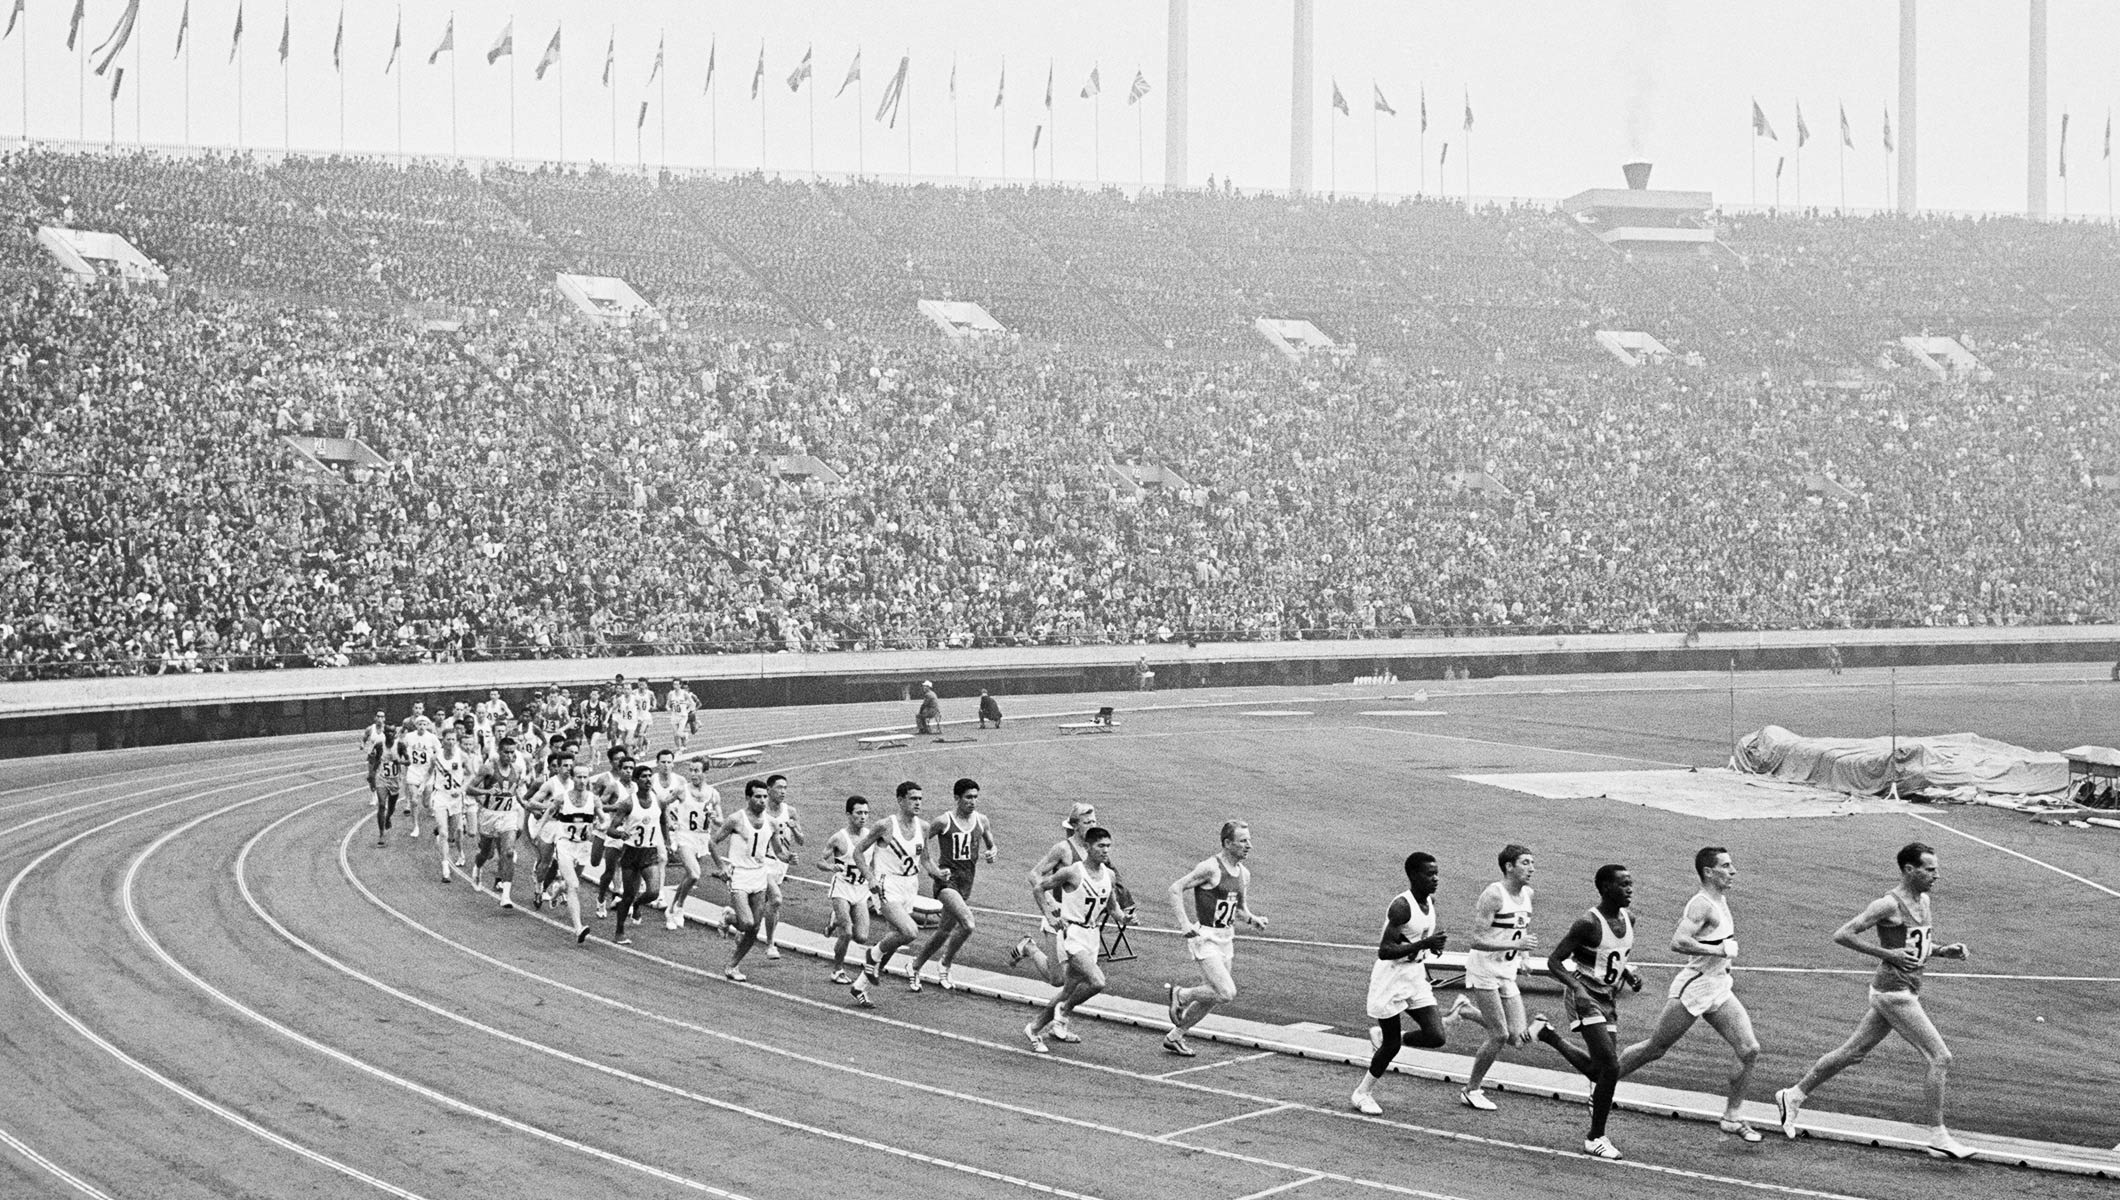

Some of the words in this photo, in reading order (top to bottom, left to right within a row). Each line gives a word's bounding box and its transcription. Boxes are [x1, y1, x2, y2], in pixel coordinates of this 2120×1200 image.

[383, 761, 399, 777] 50
[412, 750, 427, 765] 69
[751, 832, 759, 858] 1
[953, 833, 970, 860] 14
[1603, 949, 1631, 985] 6
